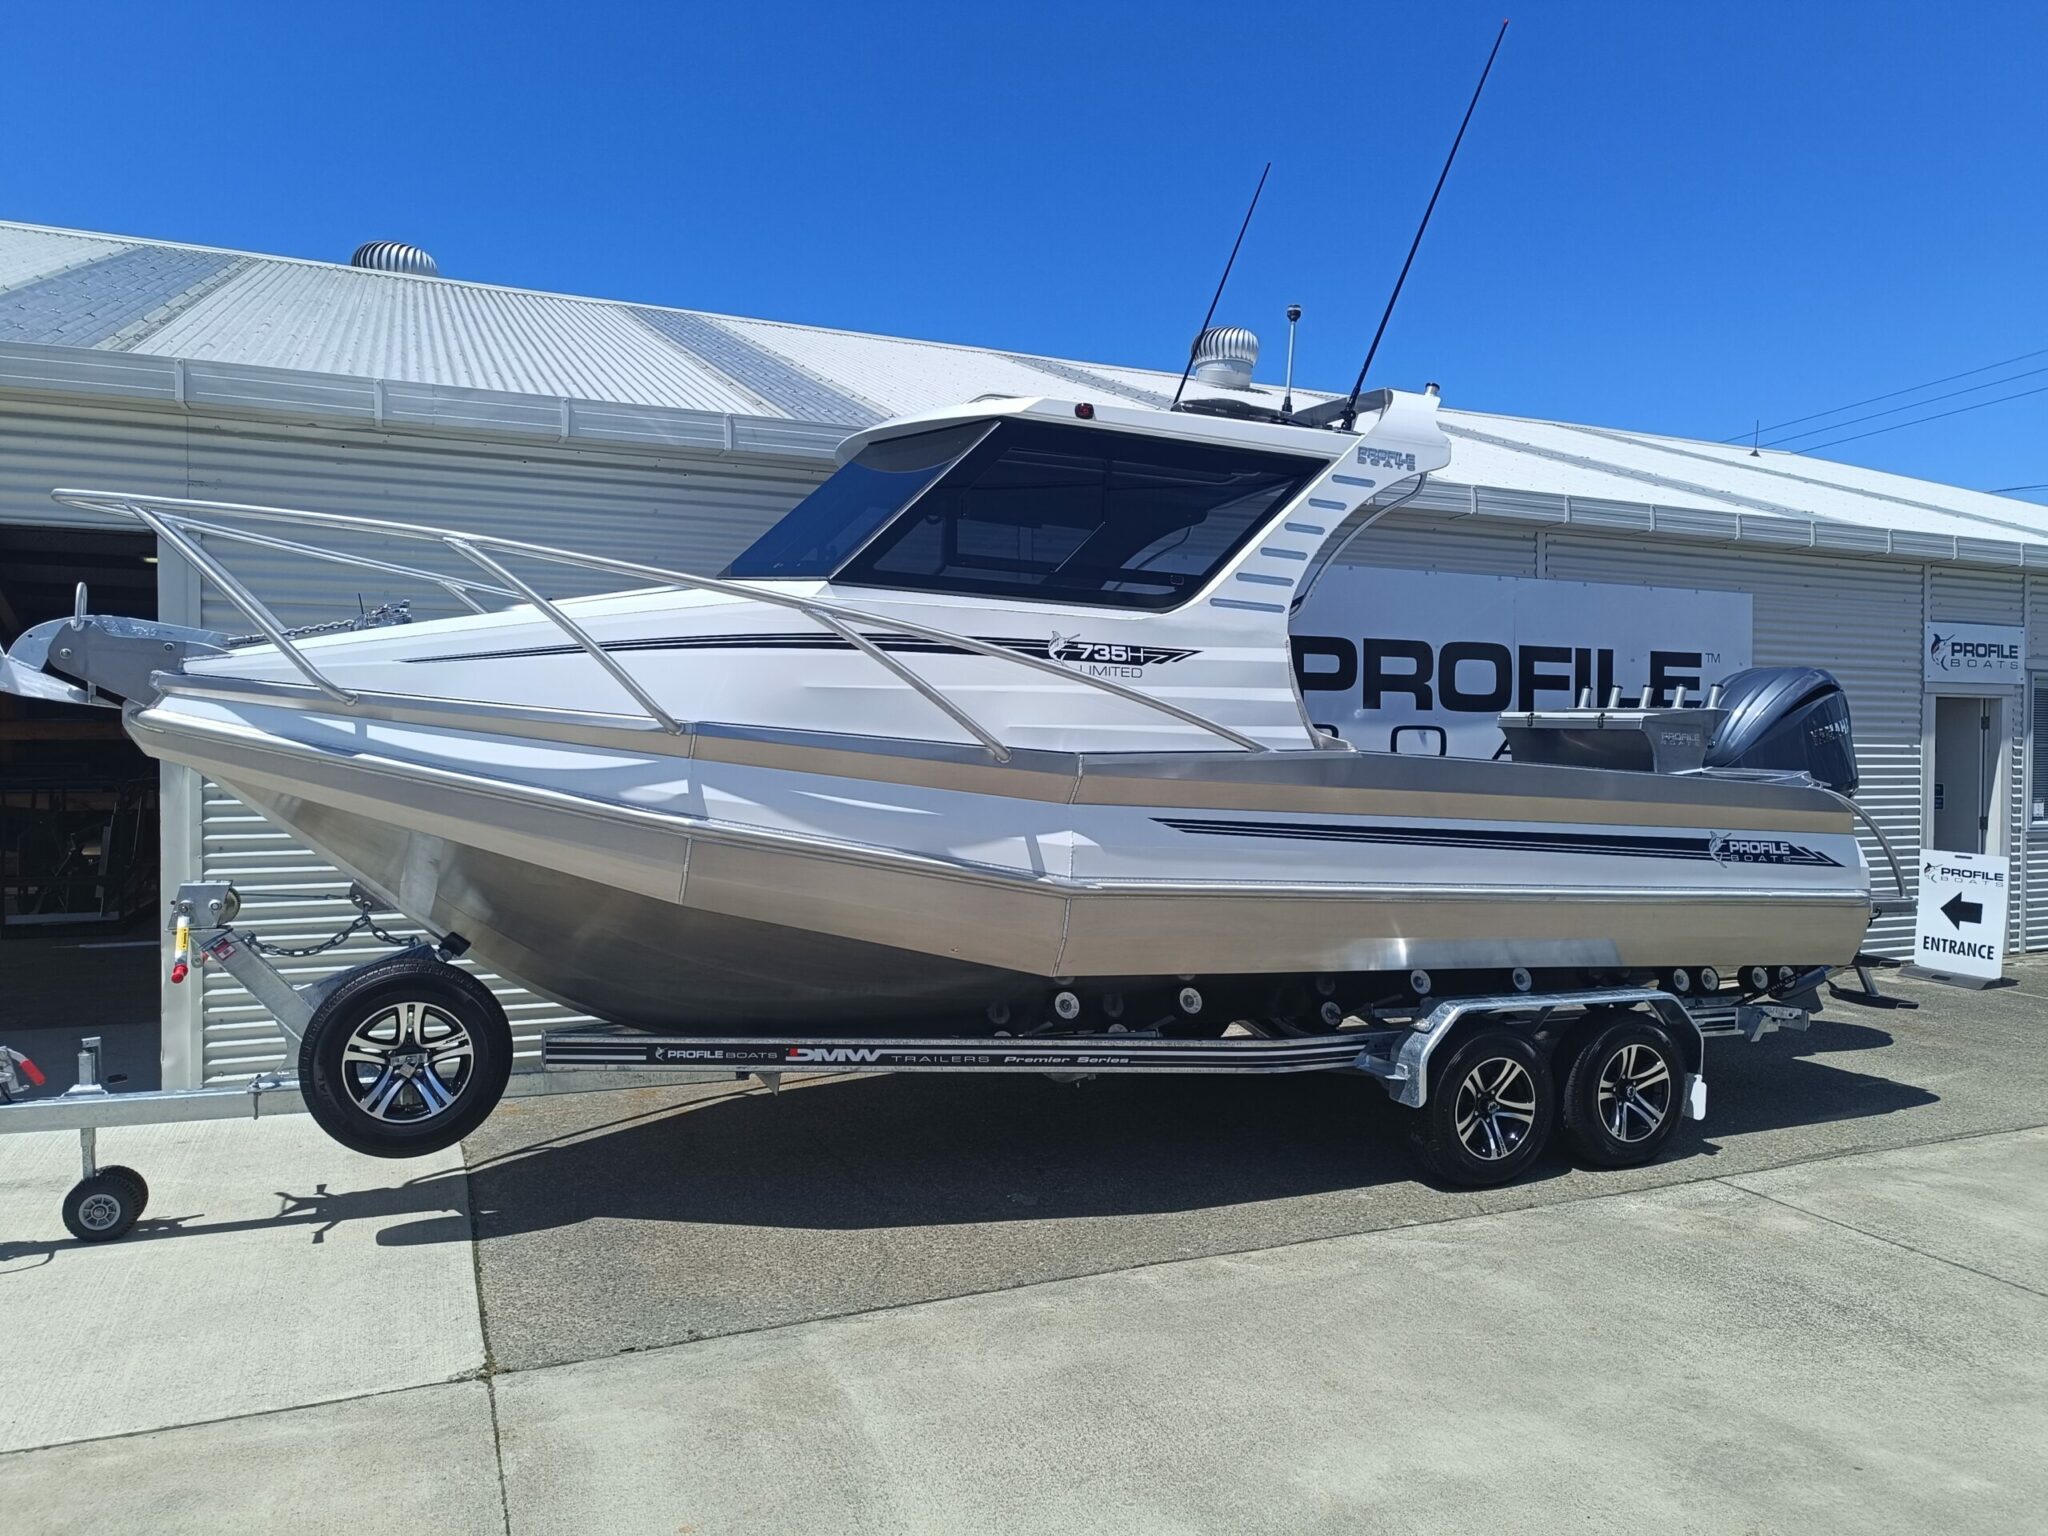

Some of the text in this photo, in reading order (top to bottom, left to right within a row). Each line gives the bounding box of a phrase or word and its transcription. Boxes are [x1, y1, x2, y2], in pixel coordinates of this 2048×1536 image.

[1077, 644, 1144, 663] 735H
[1951, 642, 2018, 659] PROFILE
[1950, 659, 2019, 670] BOATS
[1289, 635, 1702, 713] PROFILE
[1729, 841, 1790, 855] PROFILE
[1730, 854, 1792, 863] BOATS
[1940, 867, 2005, 882] PROFILE
[1940, 876, 2004, 888] BOATS
[1922, 935, 1996, 960] ENTRANCE
[667, 1050, 724, 1059] PROFILE
[725, 1051, 778, 1059] BOATS
[891, 1055, 990, 1063] TRAILERS
[1077, 1056, 1129, 1064] Series
